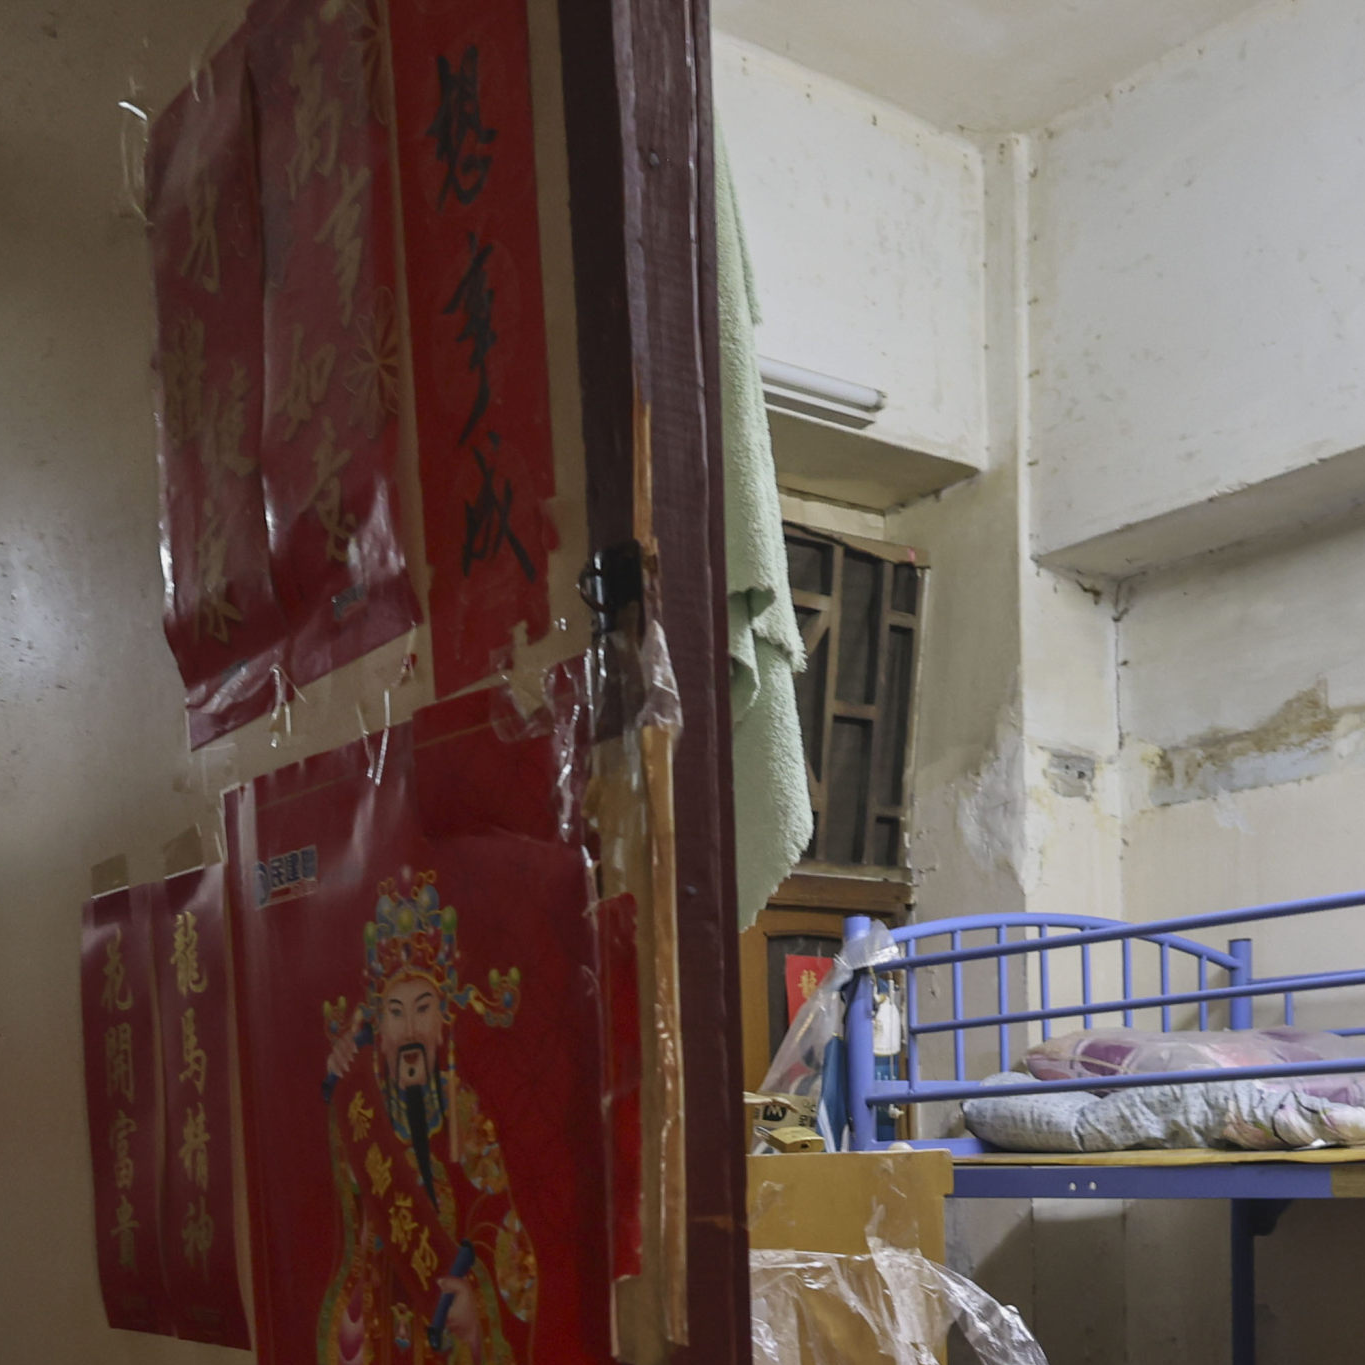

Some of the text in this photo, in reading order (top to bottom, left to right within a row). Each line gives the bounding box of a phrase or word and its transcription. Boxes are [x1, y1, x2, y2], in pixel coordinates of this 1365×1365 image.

[100, 928, 140, 1271] 花開富貴
[169, 910, 215, 1280] 龍馬精神
